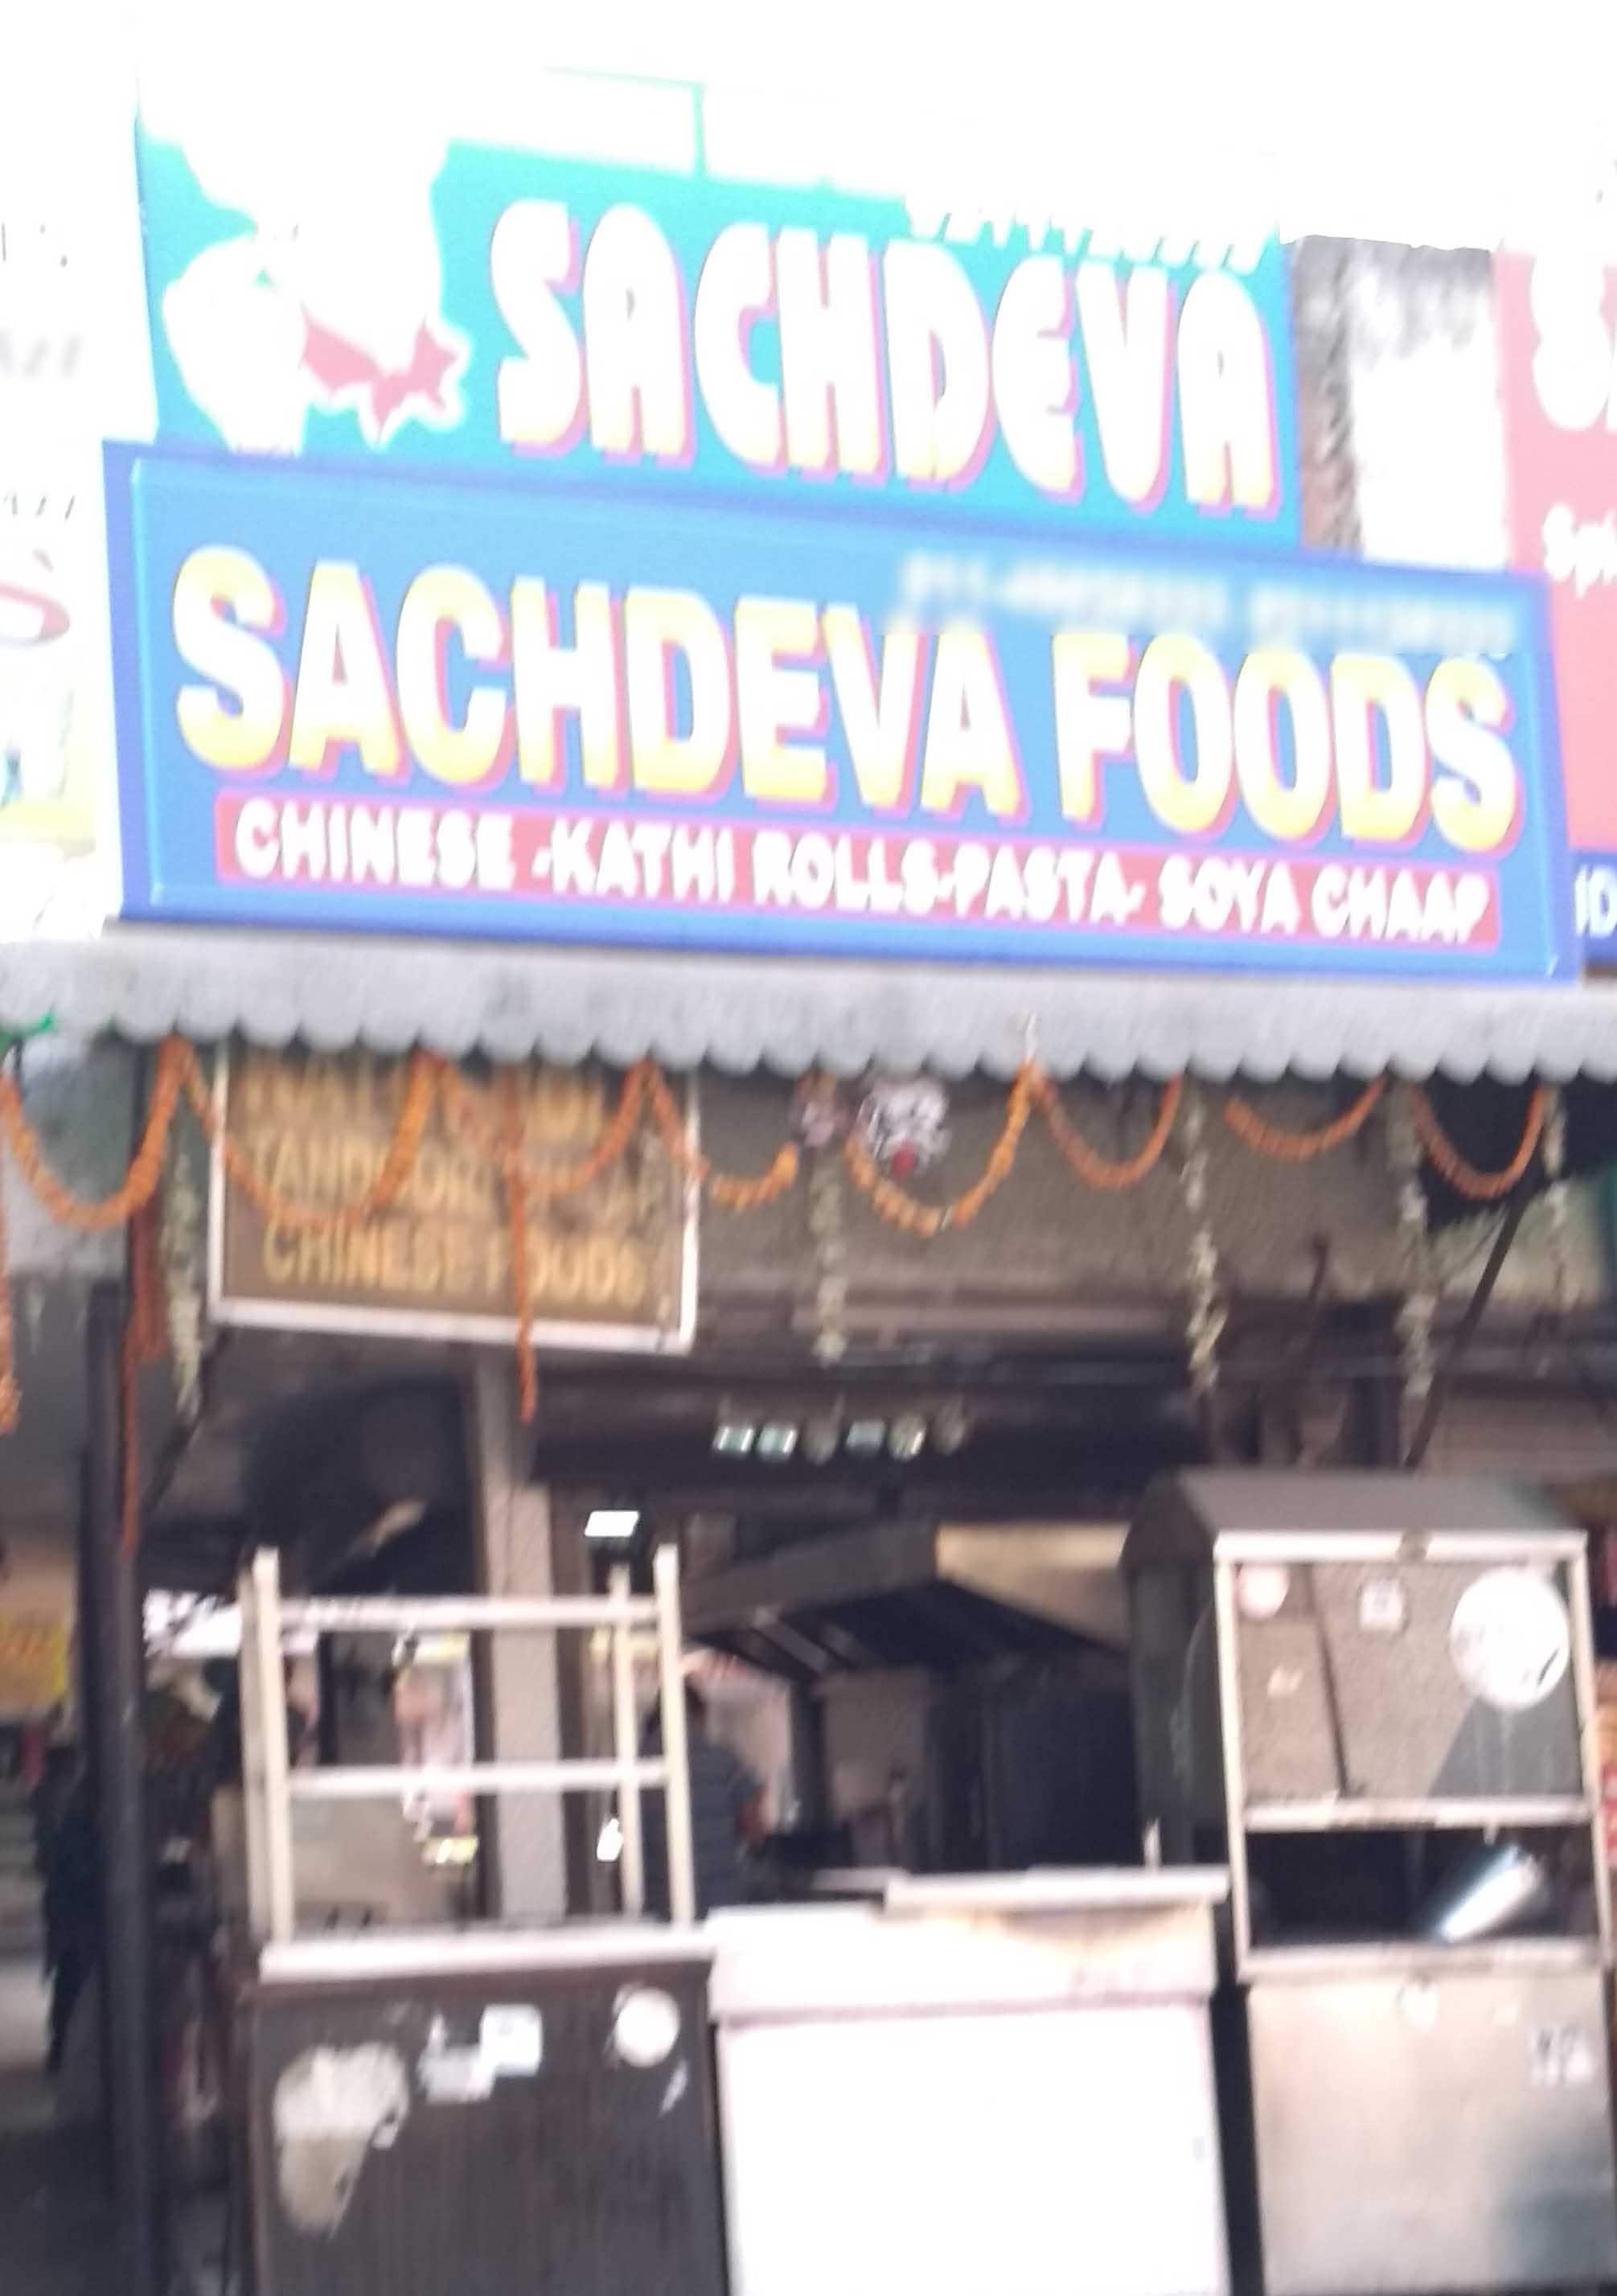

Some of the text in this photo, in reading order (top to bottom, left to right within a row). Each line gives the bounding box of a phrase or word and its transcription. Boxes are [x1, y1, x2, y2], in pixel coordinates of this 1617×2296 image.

[490, 199, 1278, 516] SACHDEVA
[173, 544, 1518, 855] SACHDEVA FOODS
[236, 798, 515, 890] CHINESE
[1159, 853, 1299, 934] SOYA
[1311, 864, 1489, 945] CHAAP
